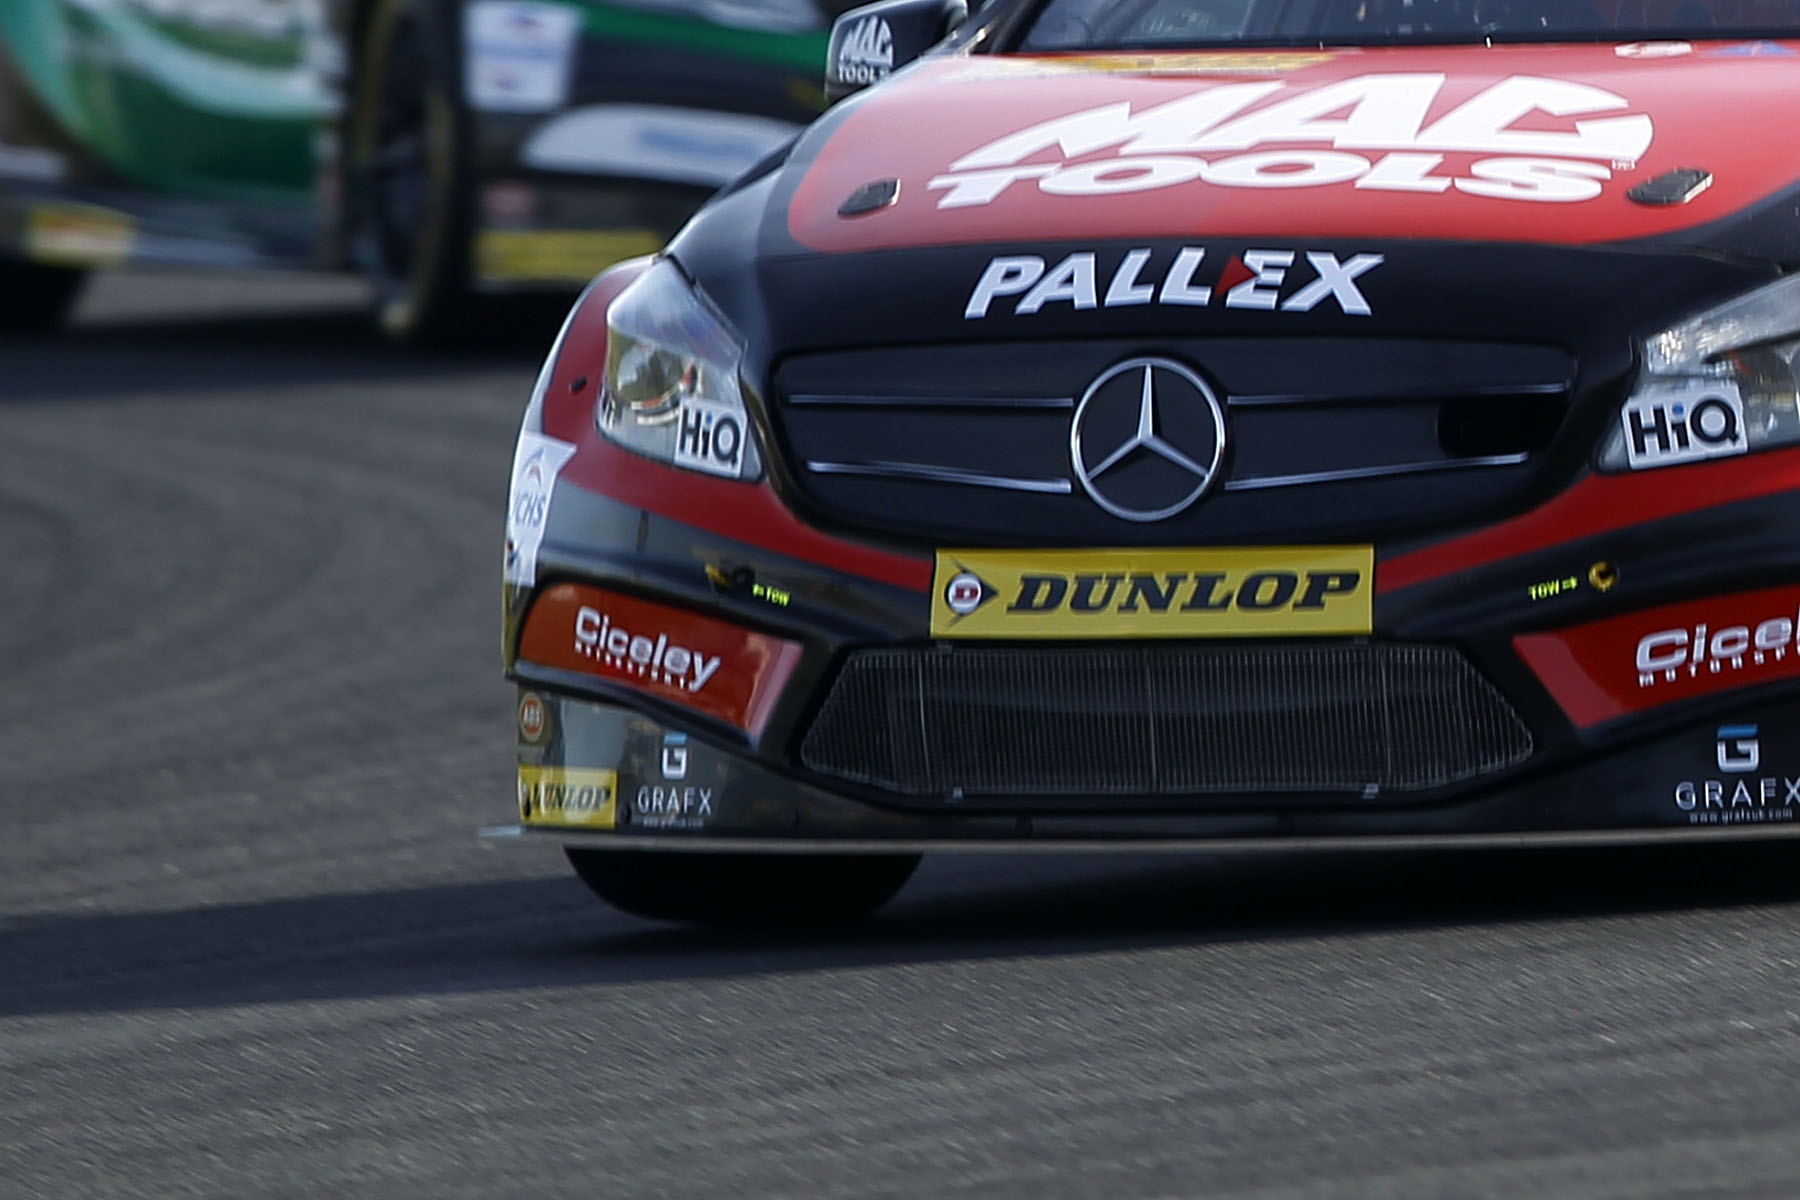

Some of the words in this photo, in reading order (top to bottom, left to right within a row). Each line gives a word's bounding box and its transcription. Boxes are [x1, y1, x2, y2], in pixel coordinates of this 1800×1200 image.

[839, 15, 893, 67] MAC
[947, 72, 1654, 171] MAC
[926, 150, 1612, 210] TOOLS
[678, 409, 742, 467] HiQ
[1628, 397, 1741, 455] HiQ
[1005, 569, 1361, 614] DUNLOP
[1528, 579, 1561, 599] TOW
[575, 605, 721, 693] Ciceley
[637, 786, 713, 815] GRAFX
